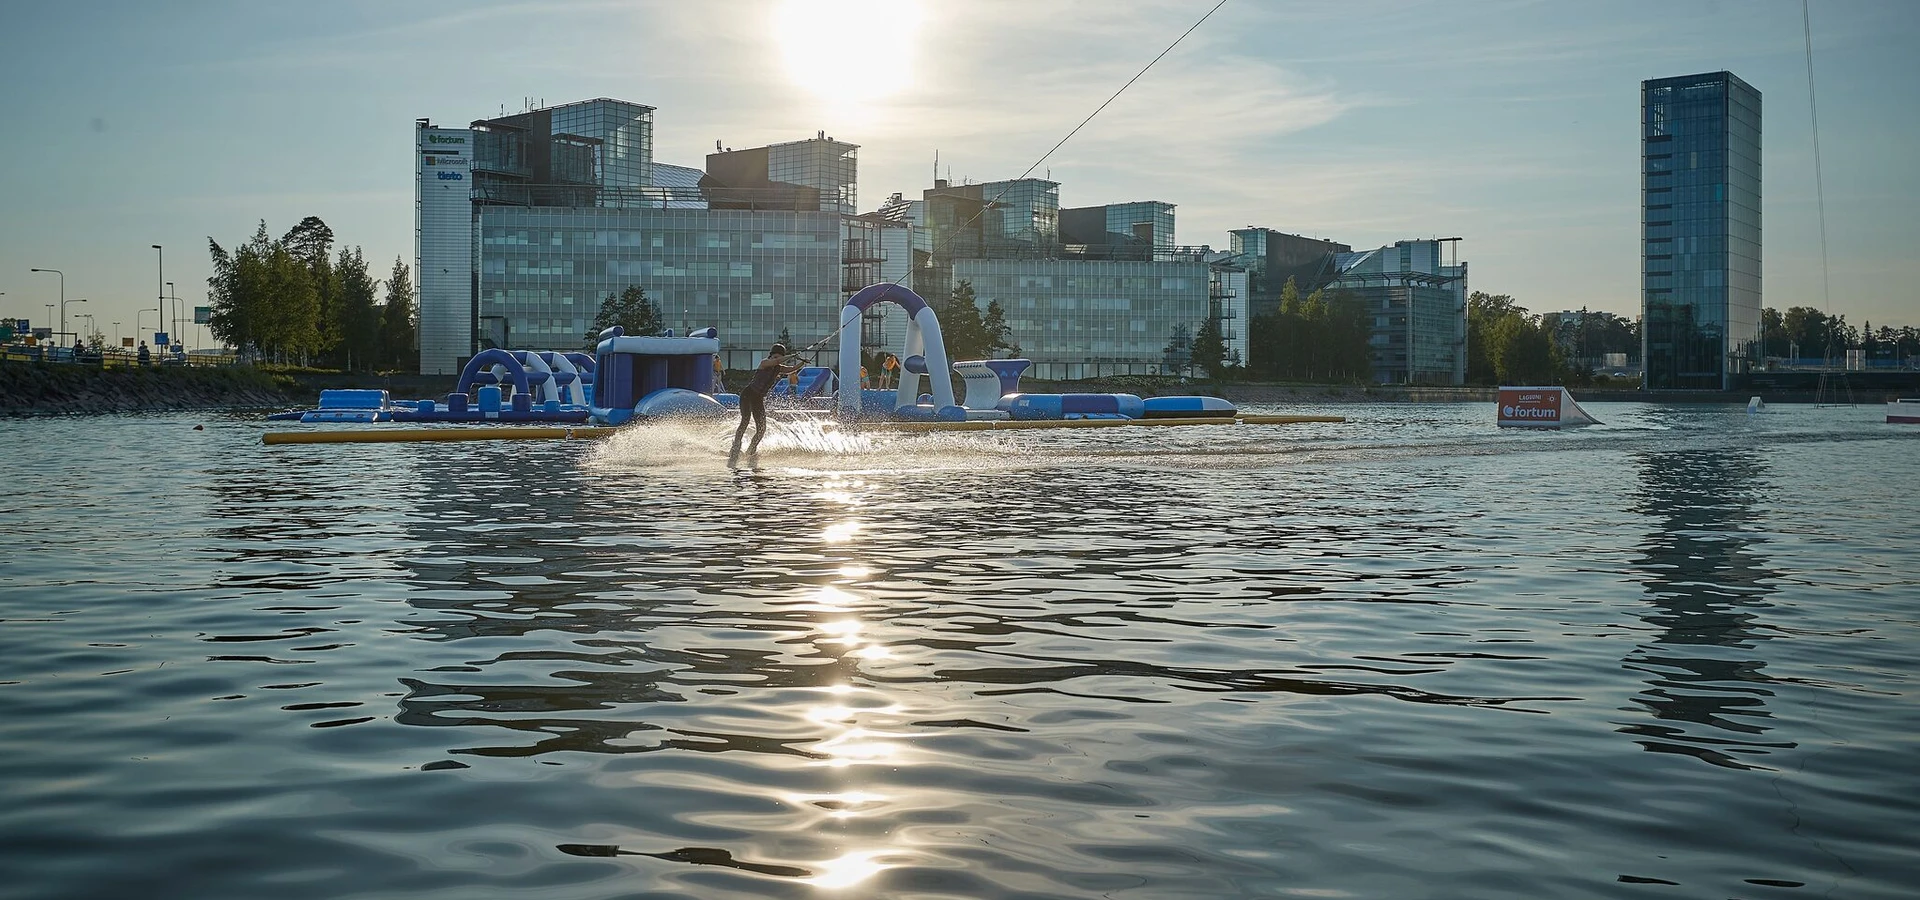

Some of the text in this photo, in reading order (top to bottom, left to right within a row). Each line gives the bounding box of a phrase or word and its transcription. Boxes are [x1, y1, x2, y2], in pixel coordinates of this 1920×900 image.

[437, 135, 465, 144] fortum
[437, 156, 468, 165] Microsoft
[437, 171, 463, 180] tieto
[1514, 405, 1556, 417] fortum
